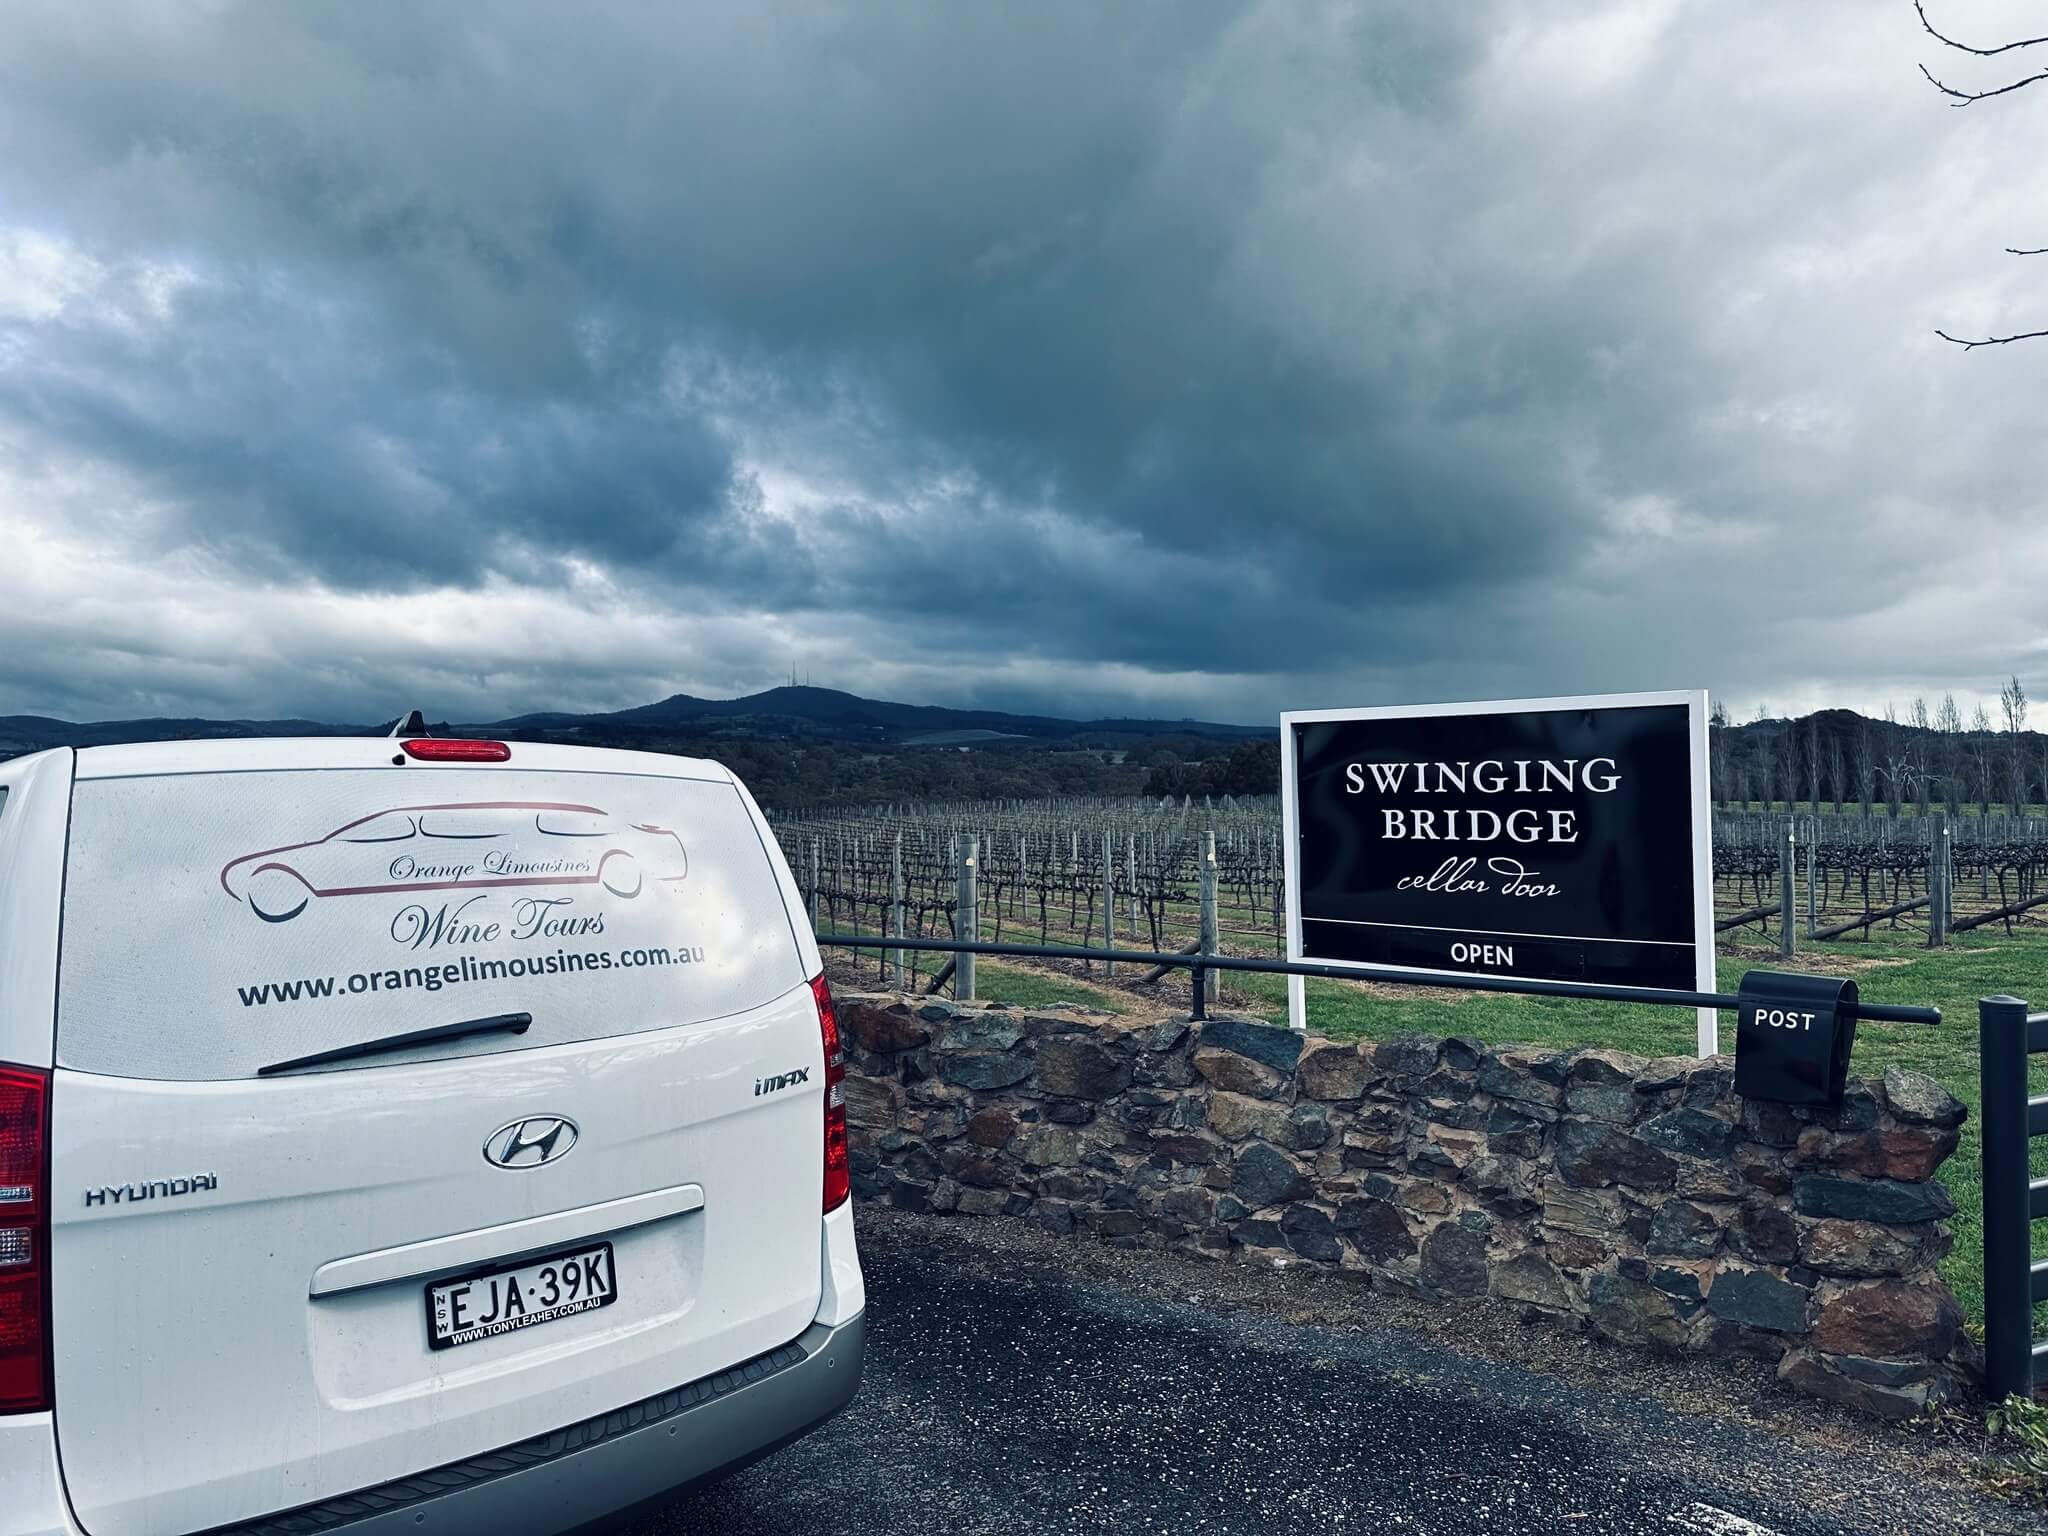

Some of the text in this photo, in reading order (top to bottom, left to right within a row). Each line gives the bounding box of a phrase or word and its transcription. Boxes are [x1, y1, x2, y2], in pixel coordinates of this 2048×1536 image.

[1346, 758, 1622, 794] SWINGING
[1381, 809, 1579, 843] BRIDGE
[389, 849, 591, 884] Orange Limousines
[1397, 856, 1561, 897] cellar door
[390, 895, 605, 951] Wine Tours
[1451, 943, 1514, 966] OPEN
[237, 942, 706, 1008] www.orangelimousines.com.au
[1754, 1008, 1815, 1031] POST
[85, 1170, 218, 1207] HYUNDAI
[451, 1297, 601, 1345] WWW.TONYLEAHEY.COM.AU
